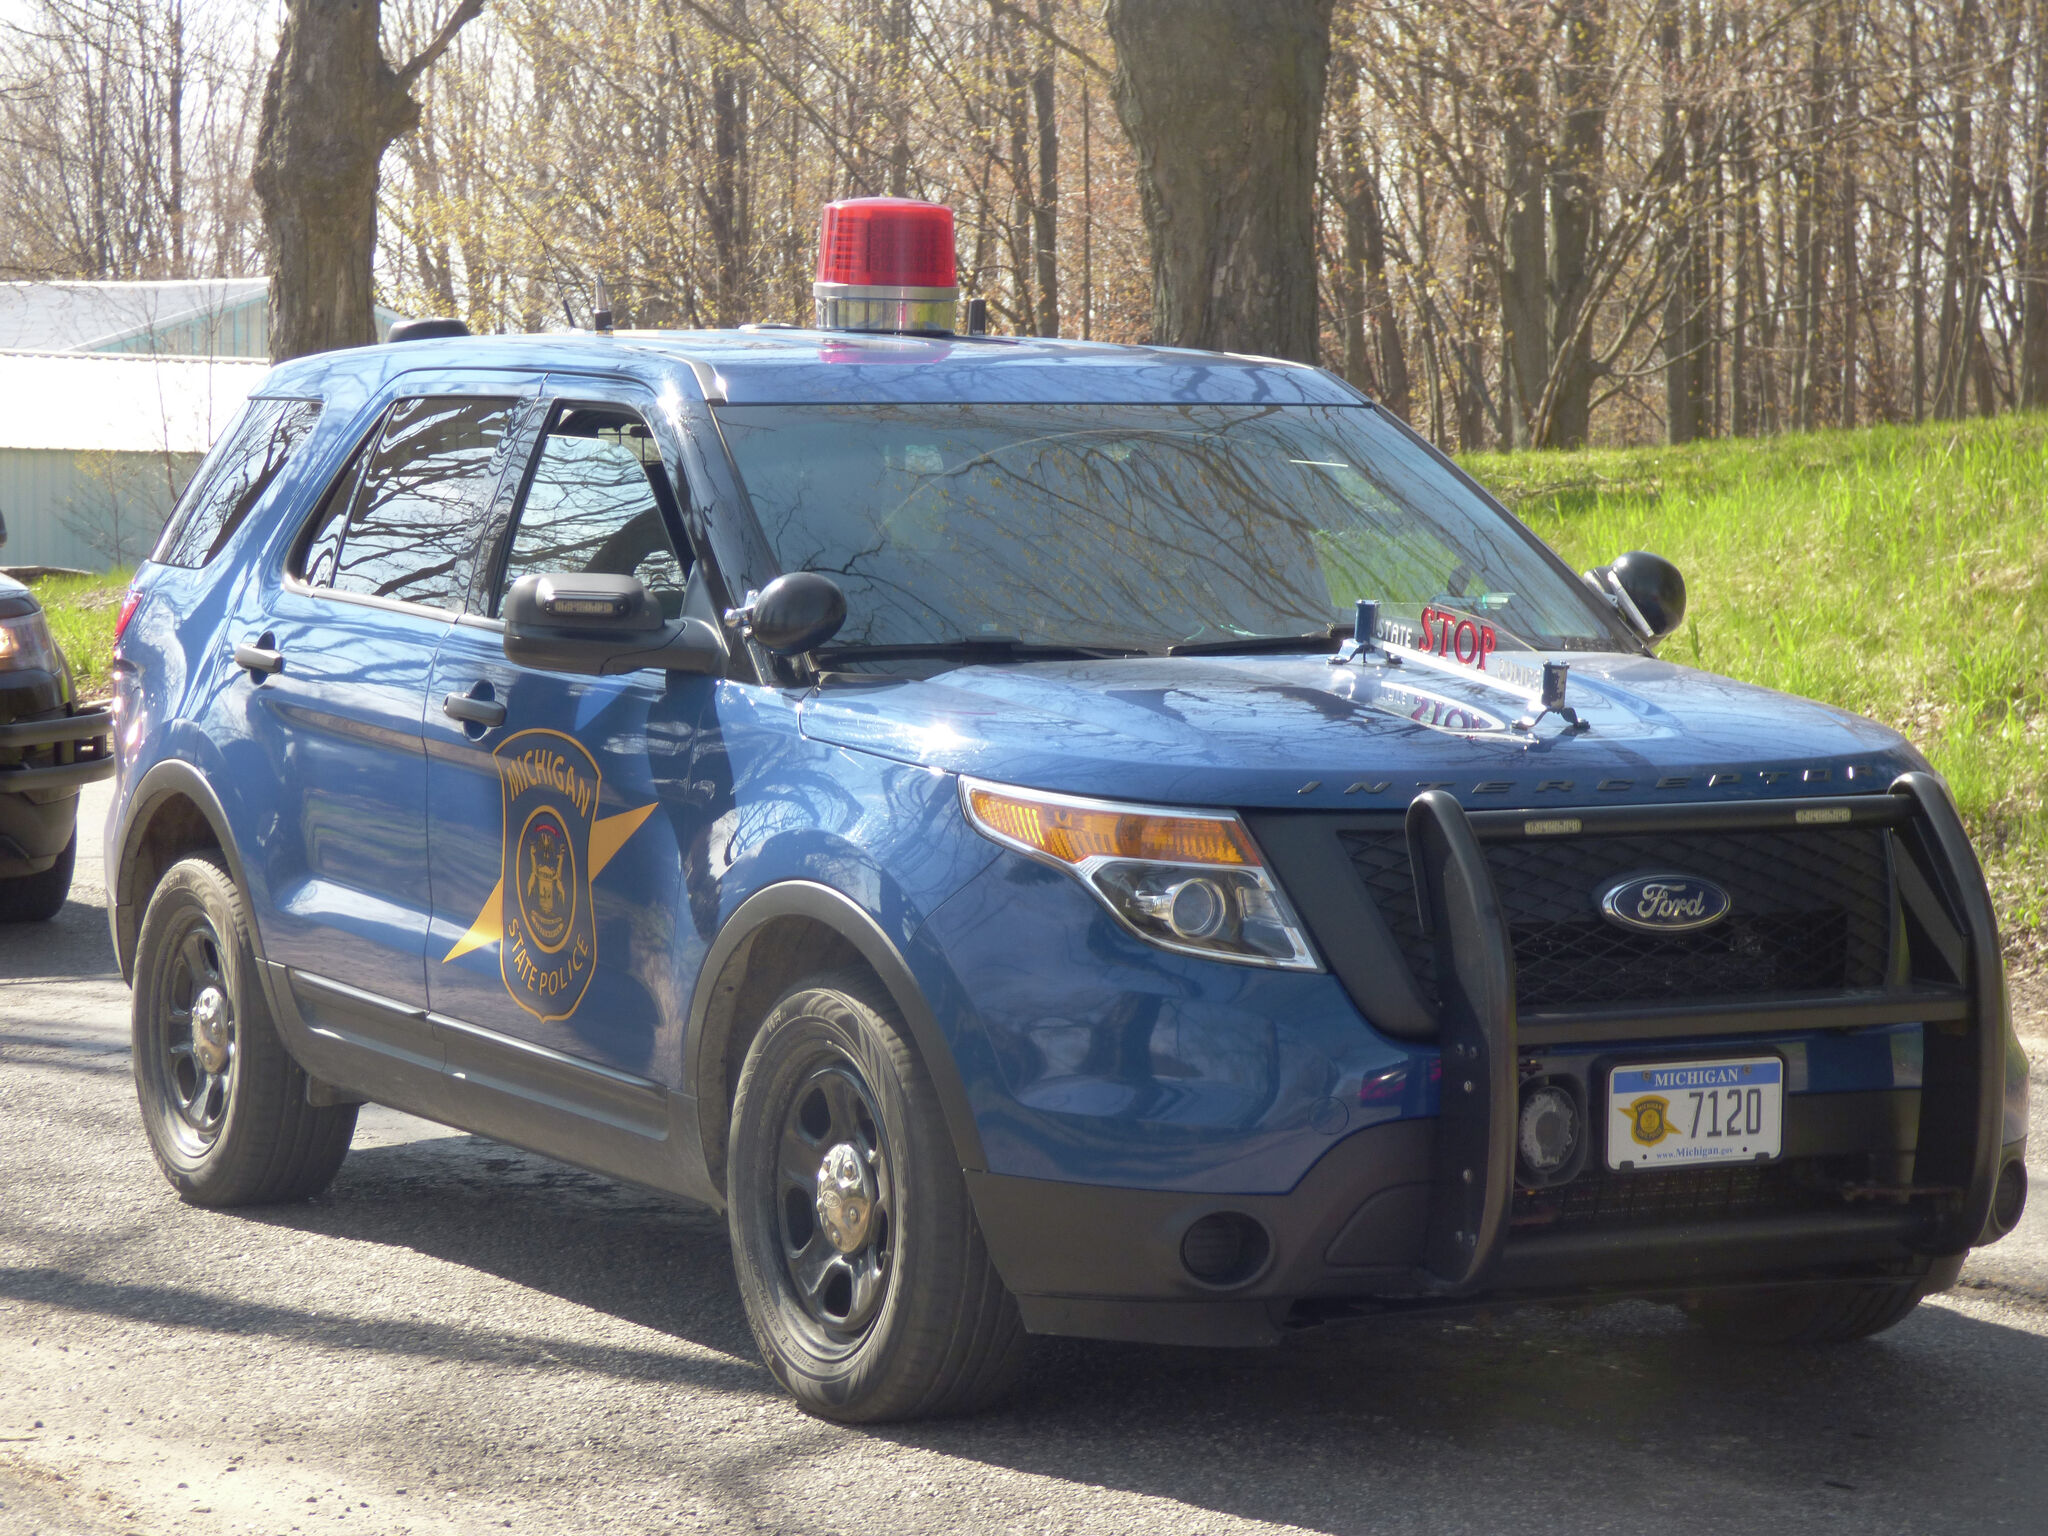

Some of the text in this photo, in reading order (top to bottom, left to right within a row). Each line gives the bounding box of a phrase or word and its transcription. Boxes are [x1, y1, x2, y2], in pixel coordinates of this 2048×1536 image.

[1377, 620, 1412, 649] STATE
[1418, 606, 1496, 671] STOP
[507, 749, 591, 818] MICHIGAN
[1297, 766, 1872, 794] INTERCEPTOR
[1638, 884, 1705, 918] Ford
[508, 918, 538, 992] STATE
[539, 933, 589, 995] POLICE
[1655, 1068, 1738, 1087] MICHIGAN
[1689, 1088, 1761, 1139] 7120
[1656, 1146, 1733, 1158] www.Michigan.gov
